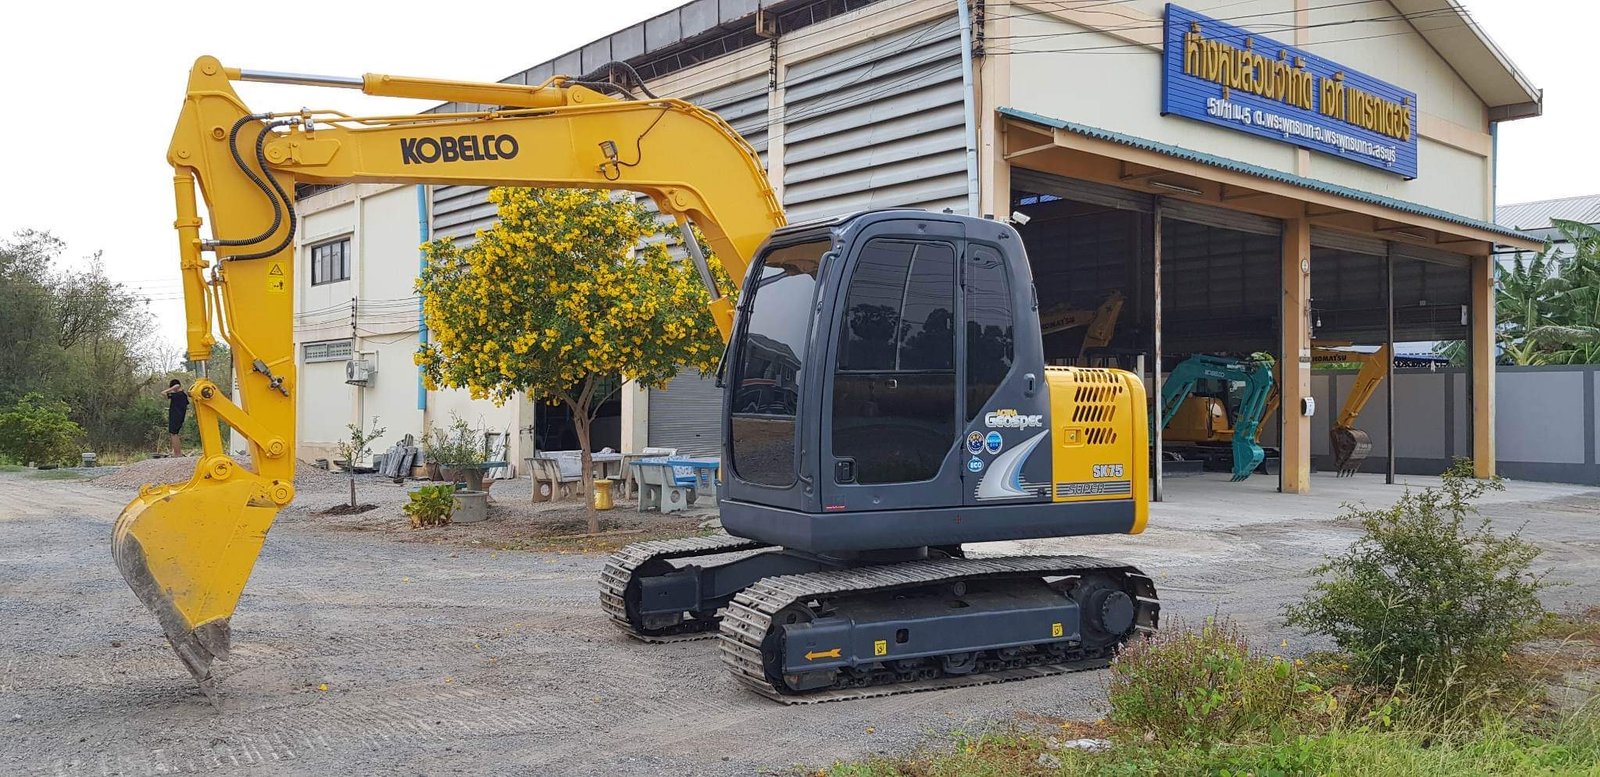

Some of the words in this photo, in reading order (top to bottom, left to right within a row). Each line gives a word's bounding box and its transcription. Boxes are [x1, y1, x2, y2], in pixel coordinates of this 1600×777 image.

[400, 134, 519, 165] KOBELCO
[985, 412, 1043, 431] Geospec
[970, 461, 982, 469] ECO
[1092, 464, 1124, 478] SK75
